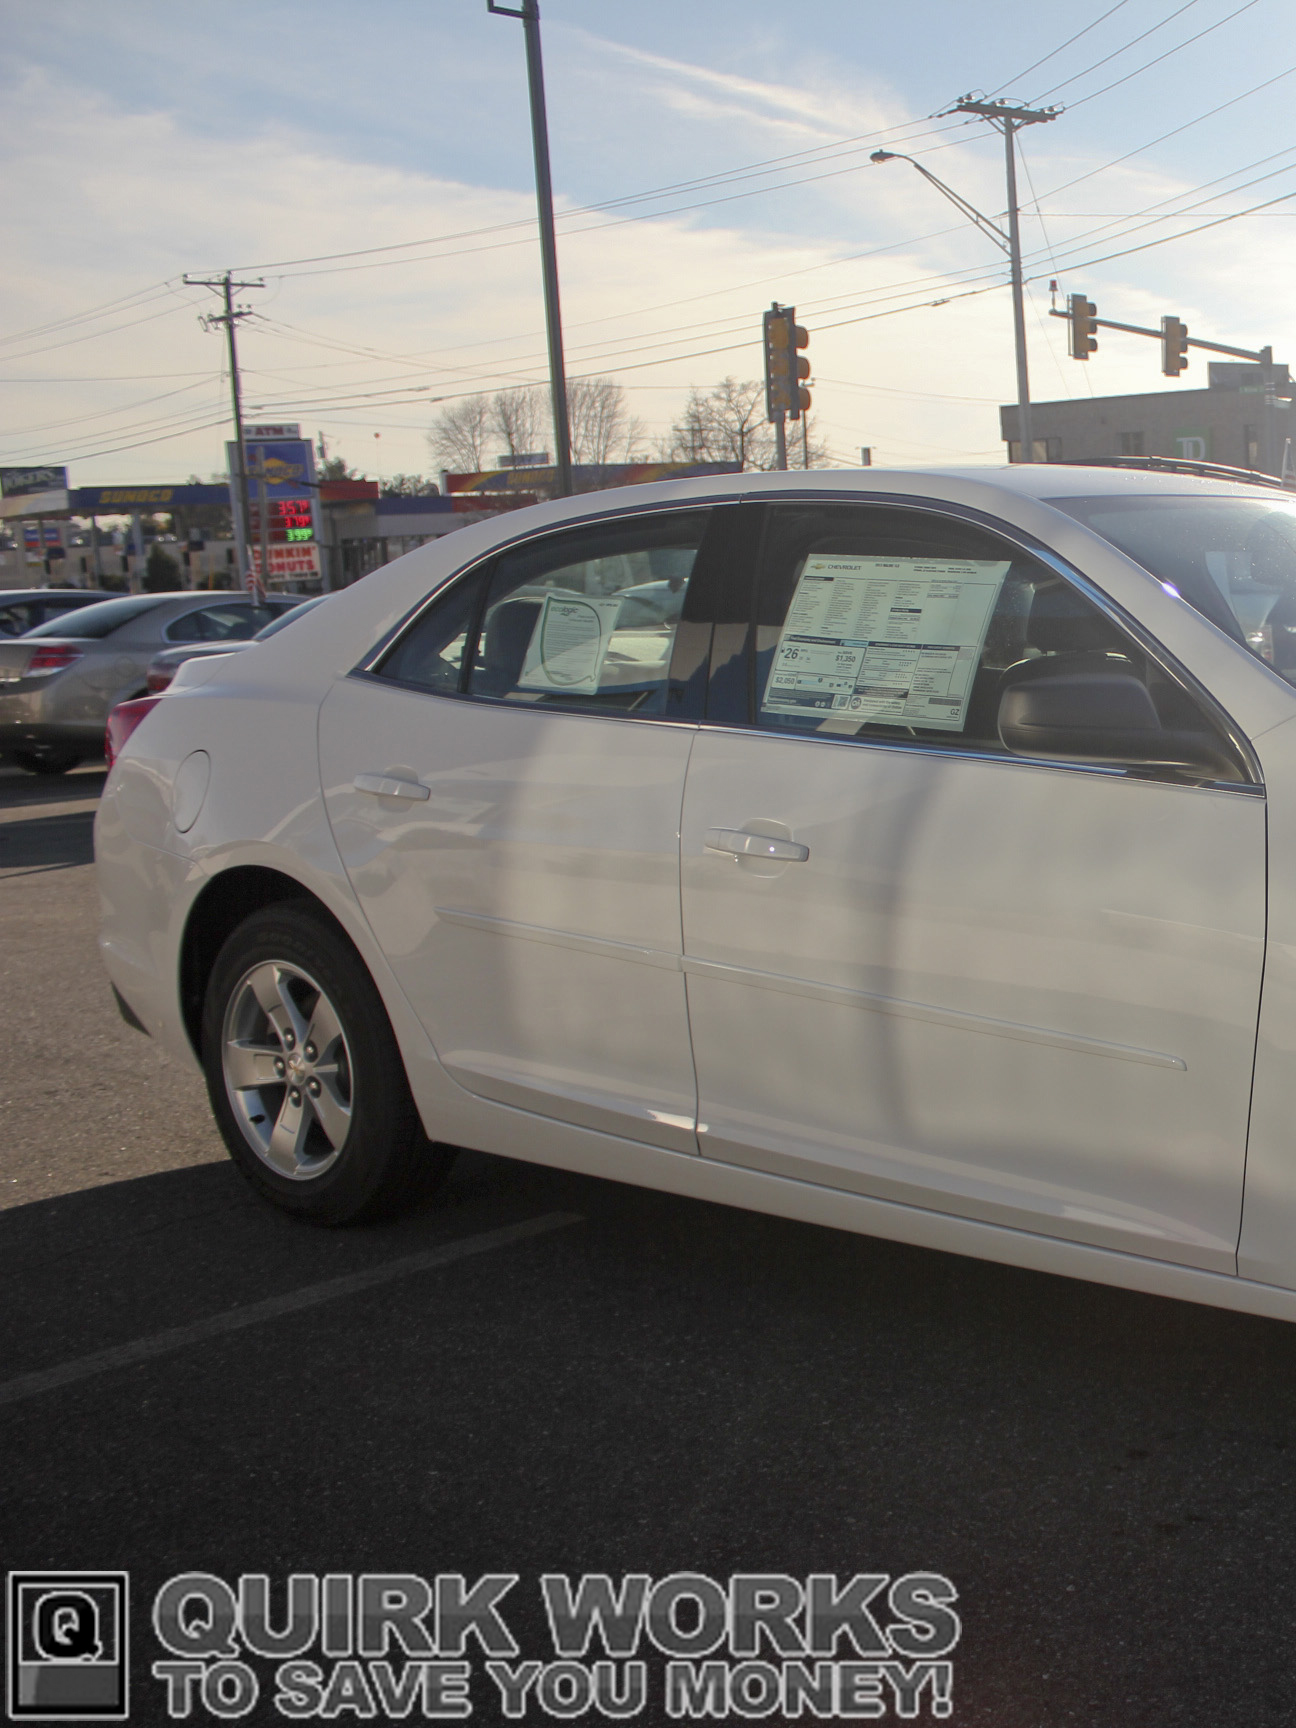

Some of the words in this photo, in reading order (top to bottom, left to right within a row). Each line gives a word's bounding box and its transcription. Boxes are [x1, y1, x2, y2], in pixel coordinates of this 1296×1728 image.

[255, 427, 285, 436] ATM
[1176, 436, 1205, 460] TD
[100, 489, 174, 503] SUNOCO
[784, 648, 799, 659] 26
[775, 677, 795, 685] $2,050
